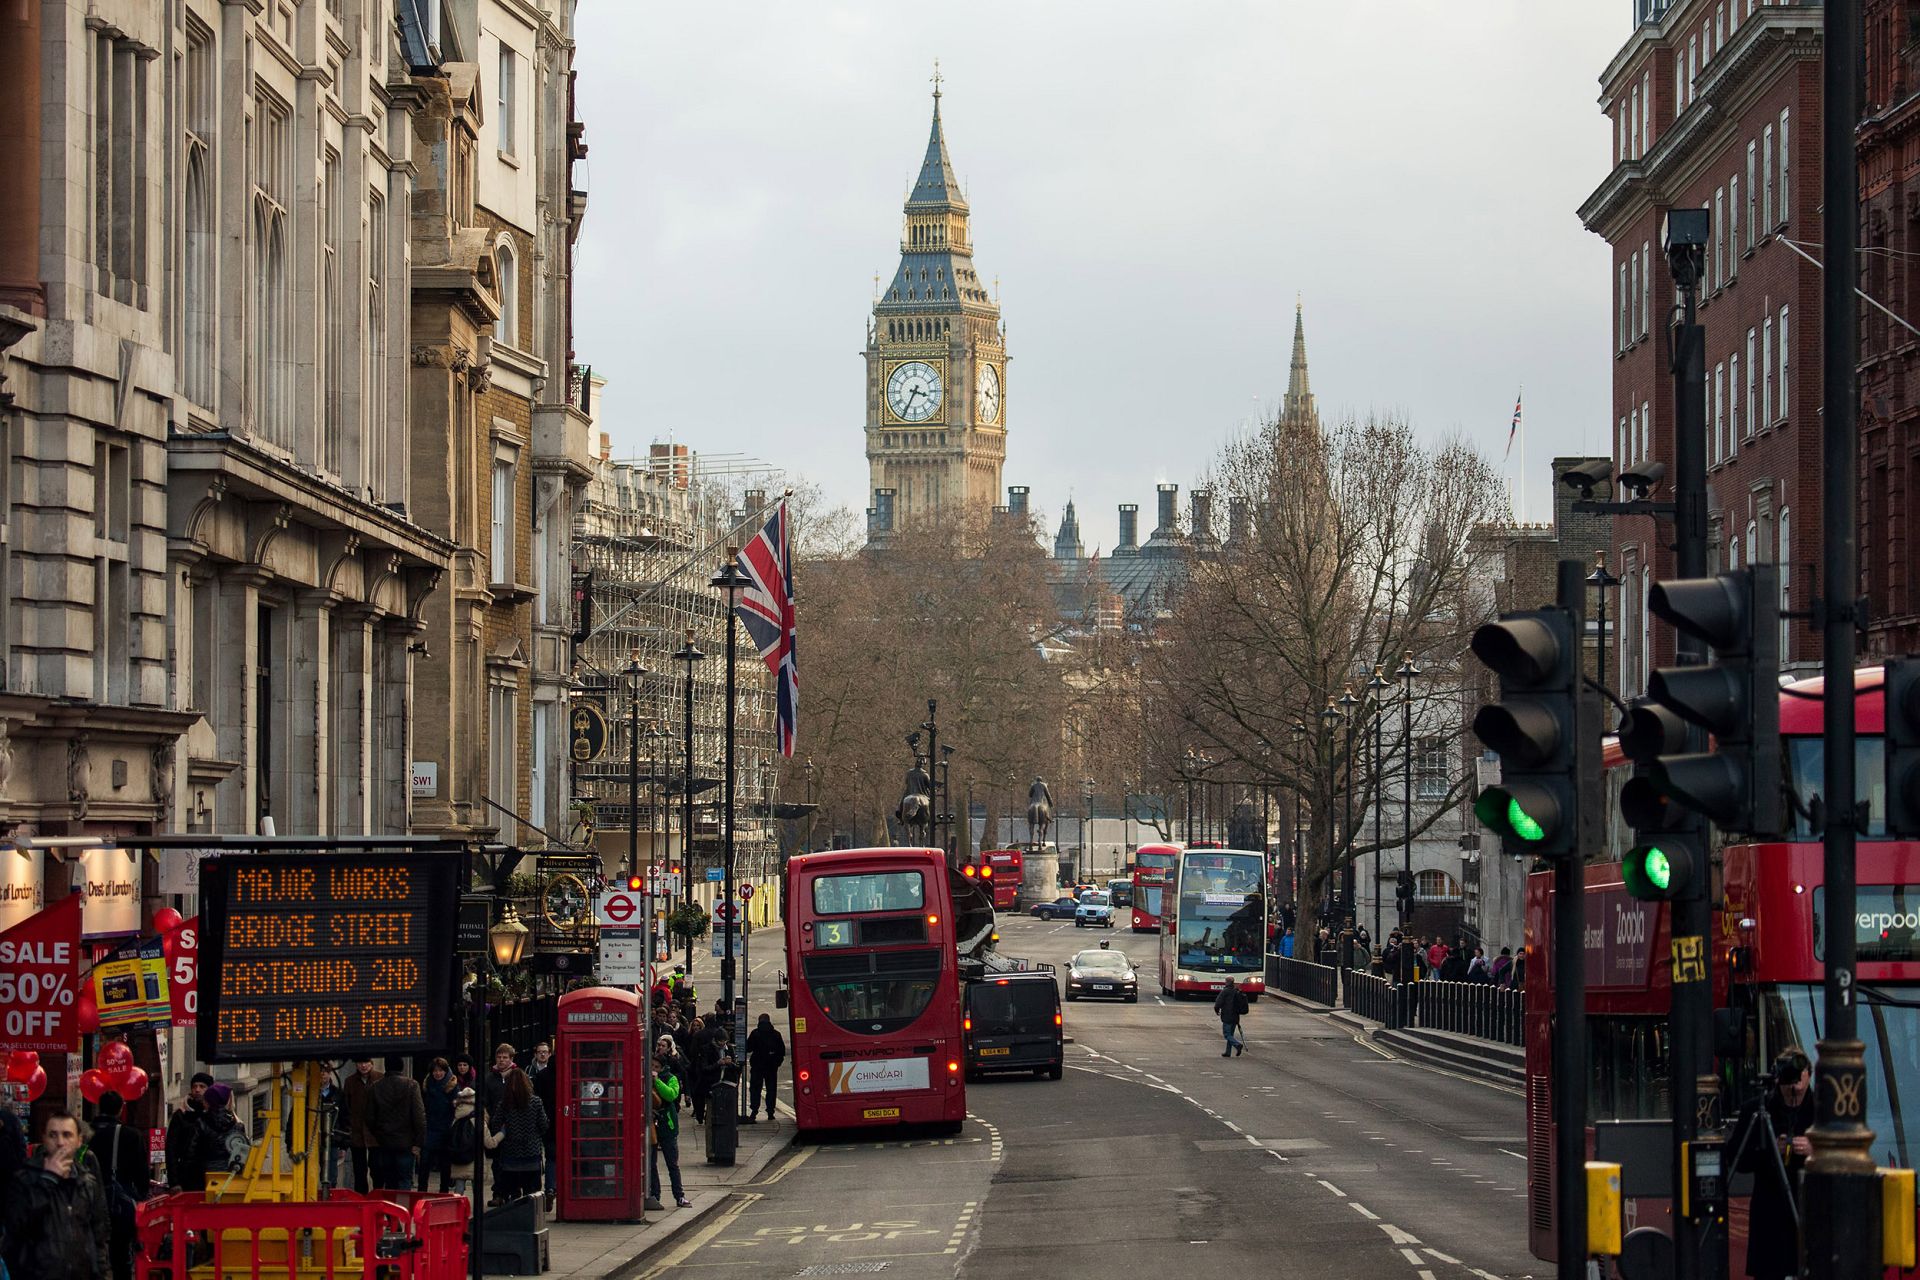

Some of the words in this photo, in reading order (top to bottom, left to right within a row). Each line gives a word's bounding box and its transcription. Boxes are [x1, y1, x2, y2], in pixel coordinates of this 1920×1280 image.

[413, 776, 432, 786] SW1
[237, 868, 316, 902] MAJOR
[330, 867, 411, 900] WORKS
[740, 887, 753, 897] M
[229, 915, 316, 948] BRIDGE
[330, 913, 413, 946] STREET
[827, 924, 841, 943] 3
[1616, 902, 1645, 944] Zoopla
[1855, 907, 1920, 935] verpool
[0, 941, 70, 964] SALE
[0, 973, 74, 1006] 50%
[221, 960, 357, 996] EASTBOUND
[371, 959, 418, 991] 2ND
[6, 1010, 61, 1036] OFF
[218, 1009, 261, 1043] FEB
[275, 1007, 347, 1040] AVOID
[361, 1003, 421, 1037] AREA
[571, 1013, 626, 1022] TELEPHONE
[10, 1042, 46, 1050] SELECTED
